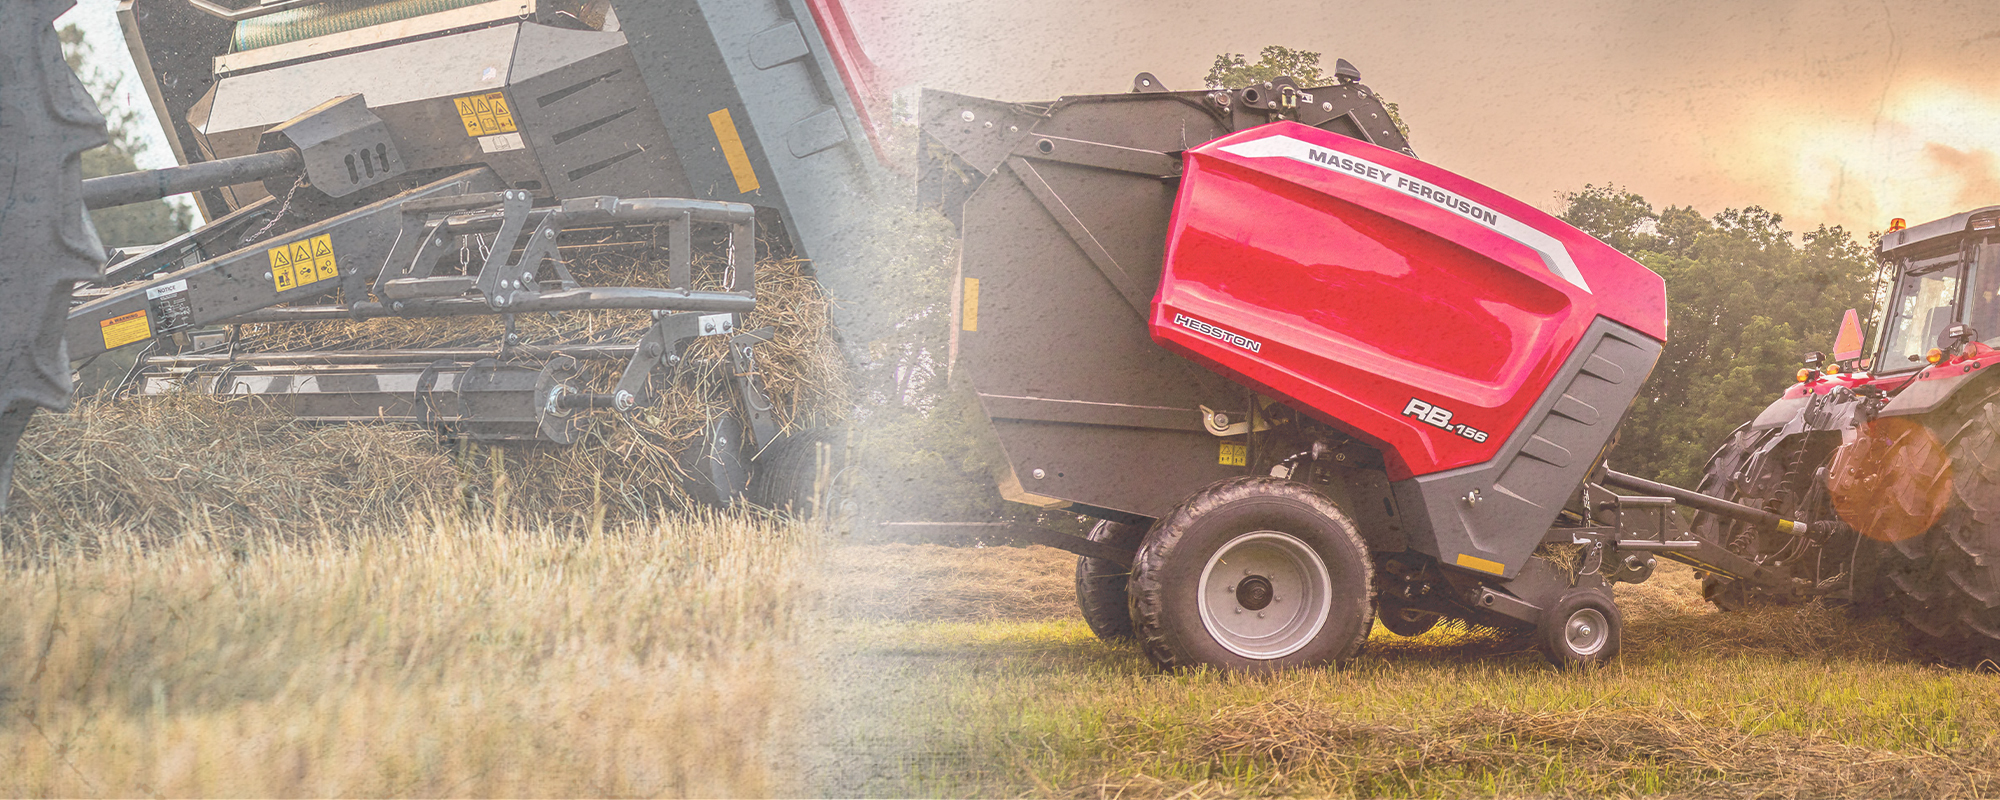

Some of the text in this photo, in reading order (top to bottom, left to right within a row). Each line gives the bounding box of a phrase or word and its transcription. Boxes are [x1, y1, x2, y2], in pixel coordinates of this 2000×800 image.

[1308, 148, 1498, 226] MASSEY FERGUSON
[157, 284, 176, 294] NOTICE
[114, 313, 139, 323] WARNING
[1174, 313, 1261, 353] HESSTON
